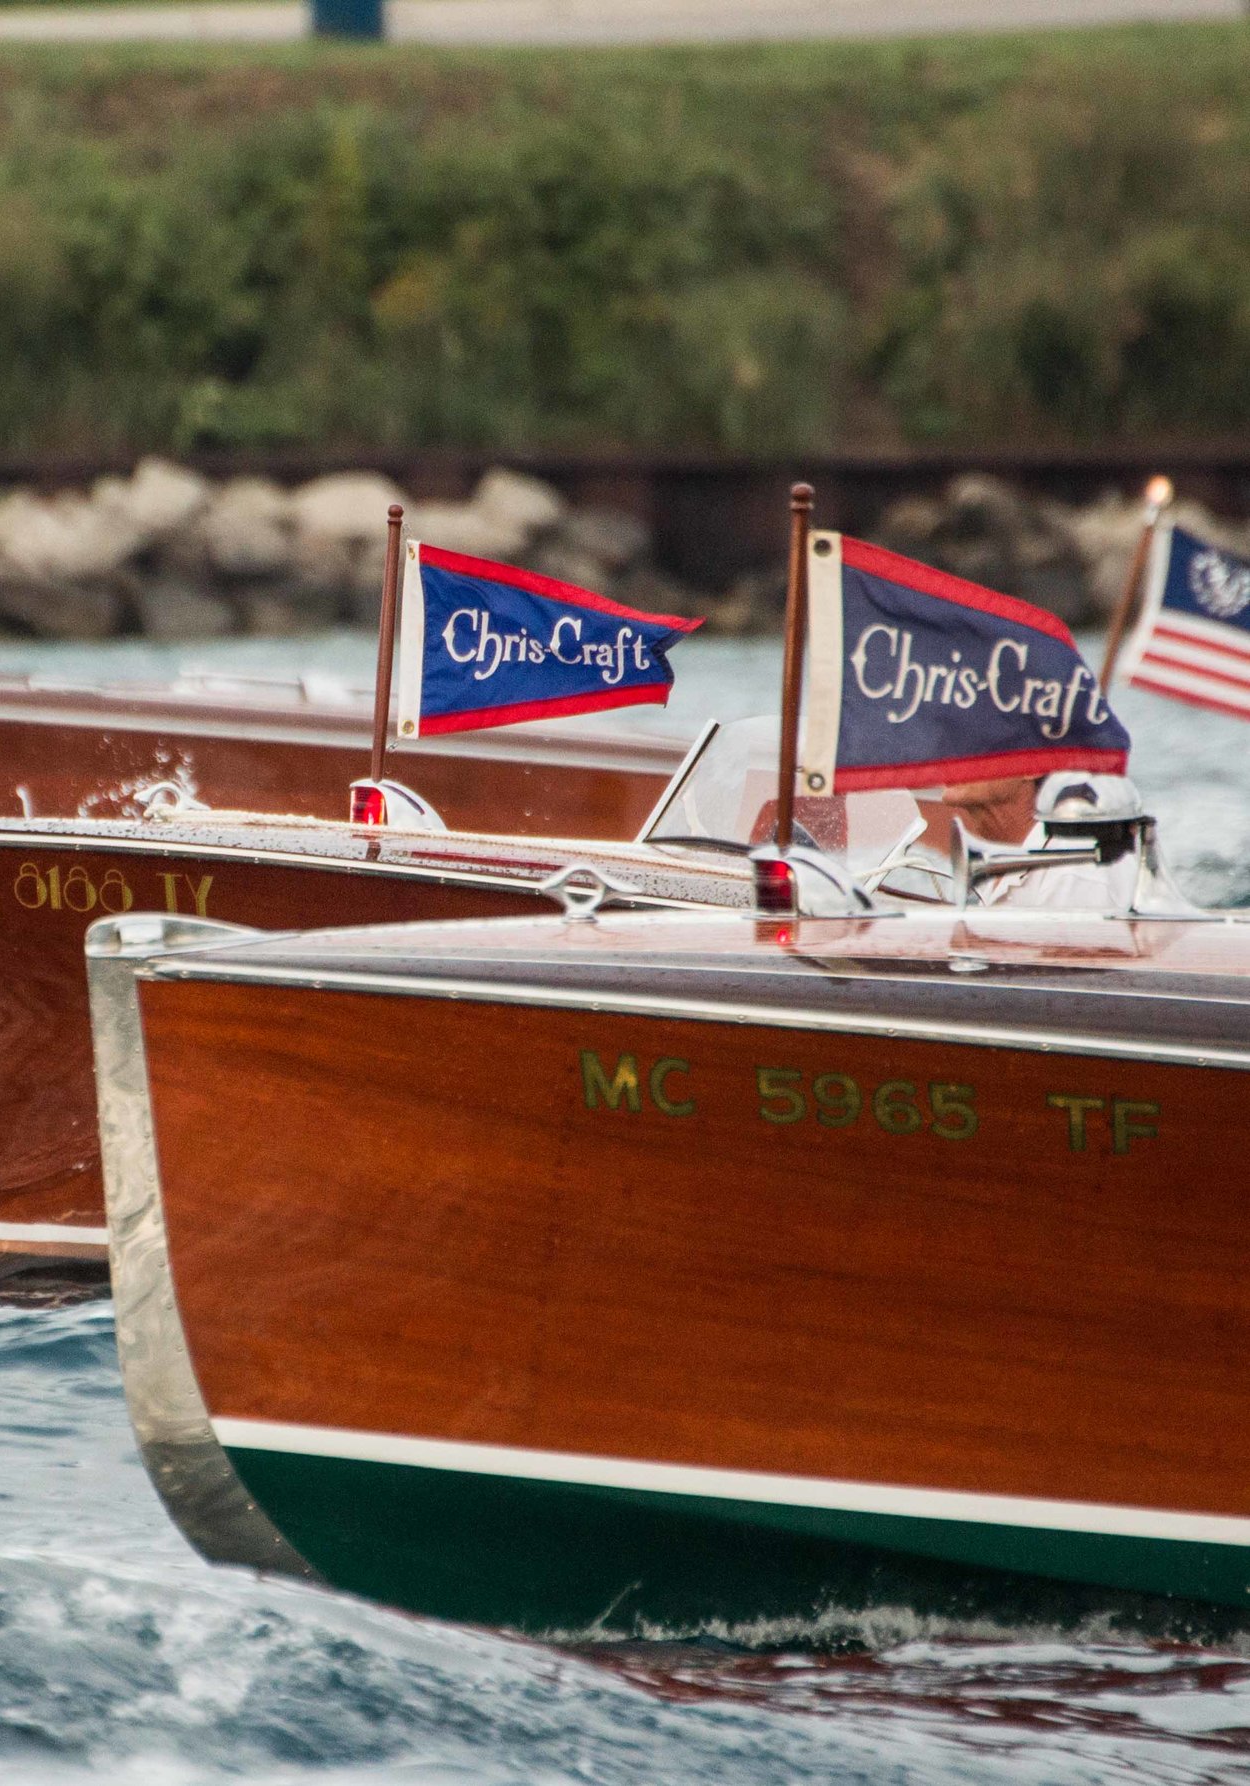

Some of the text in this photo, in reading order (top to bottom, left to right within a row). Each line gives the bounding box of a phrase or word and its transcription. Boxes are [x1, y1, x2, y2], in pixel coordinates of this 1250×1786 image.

[442, 609, 650, 684] Chris-Craft
[850, 624, 1108, 738] Chris-Craft
[14, 862, 133, 914] 8188
[156, 872, 214, 916] TY
[579, 1049, 1161, 1156] MC 5965 TF
